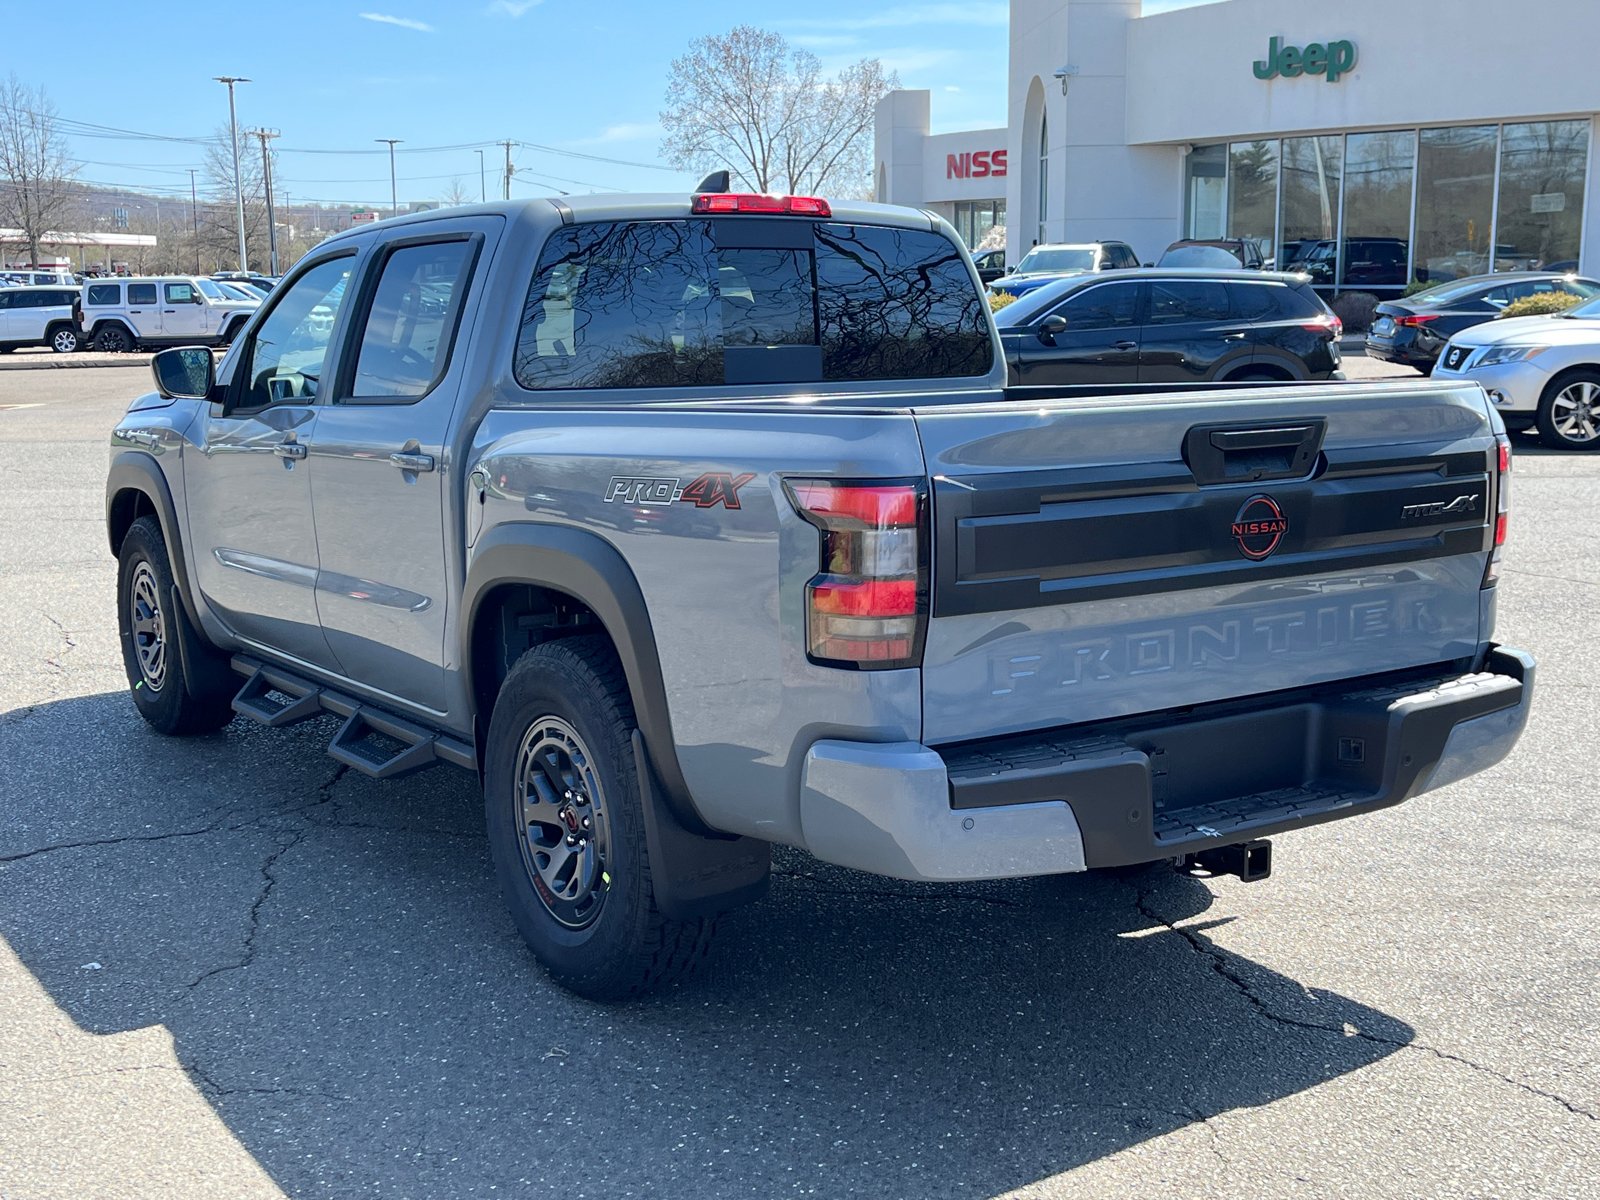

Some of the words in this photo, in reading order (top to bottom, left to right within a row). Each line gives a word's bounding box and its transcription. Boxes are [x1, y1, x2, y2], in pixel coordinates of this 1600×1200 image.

[1252, 35, 1359, 83] Jeep
[1231, 520, 1287, 535] NISSAN
[988, 594, 1443, 695] FRONTIER
